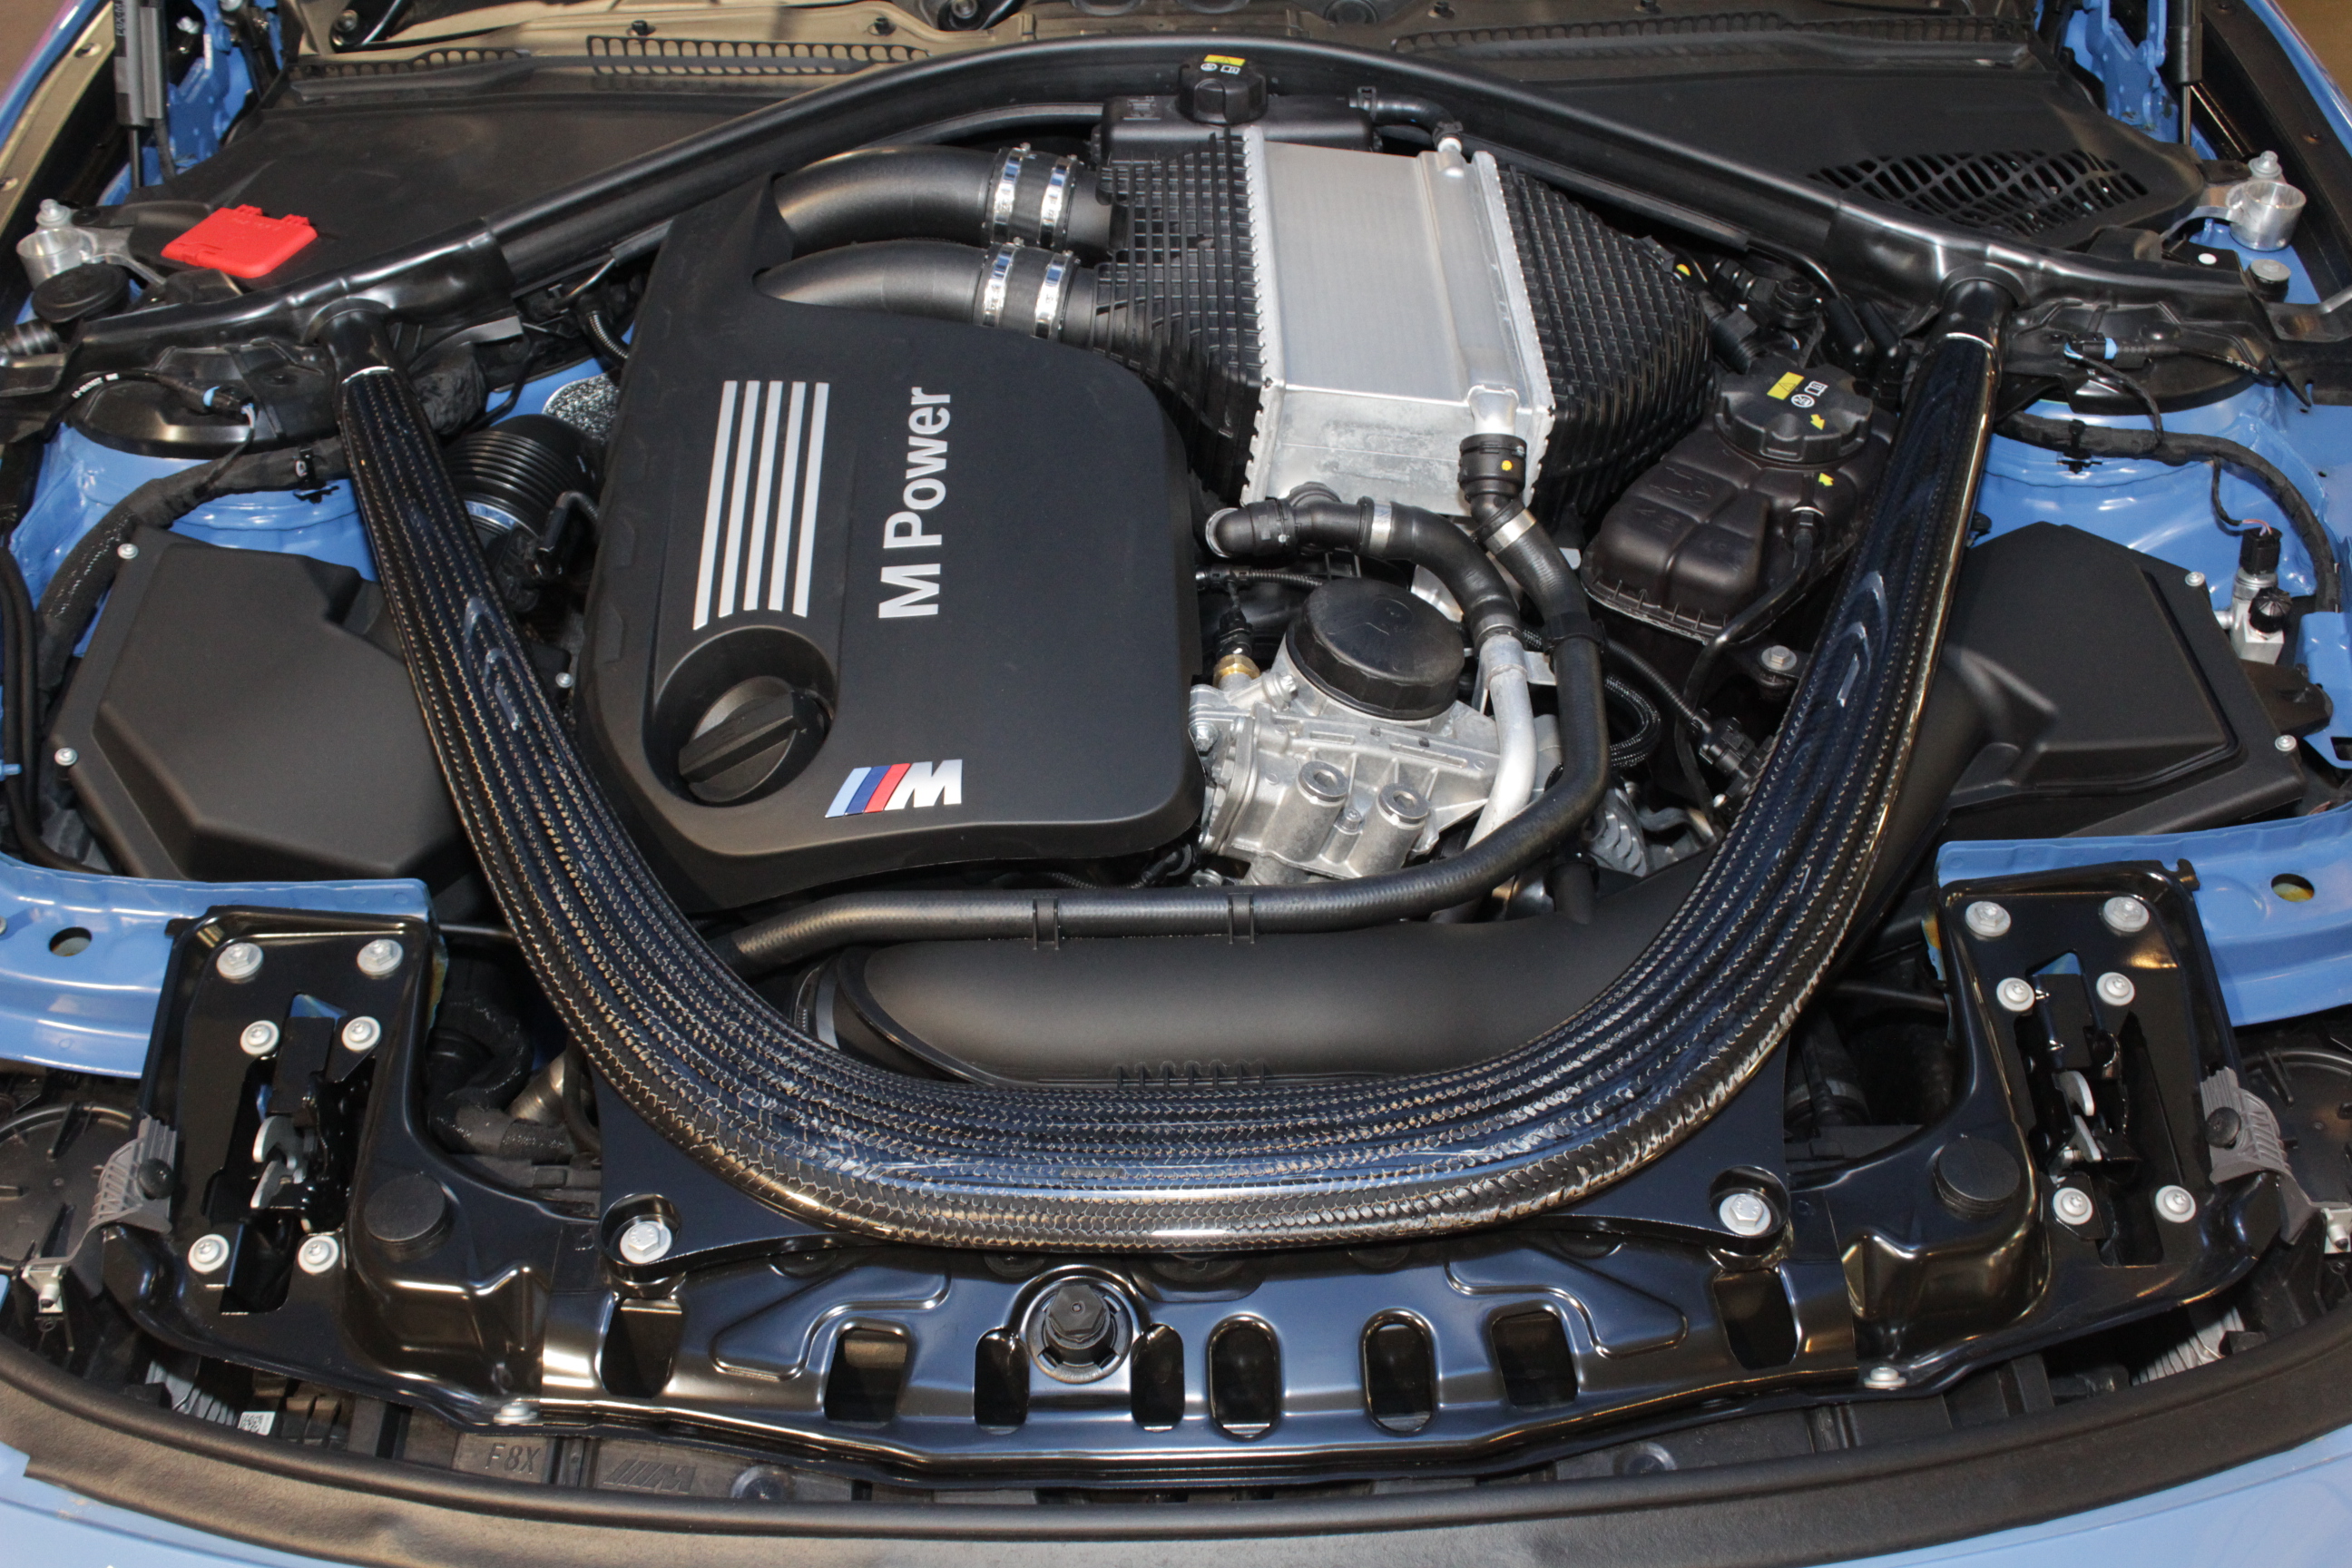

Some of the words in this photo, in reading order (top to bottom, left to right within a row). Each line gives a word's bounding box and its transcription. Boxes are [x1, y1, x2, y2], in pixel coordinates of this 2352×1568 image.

[882, 386, 951, 549] Power
[877, 563, 942, 619] M
[485, 1442, 542, 1475] F8X
